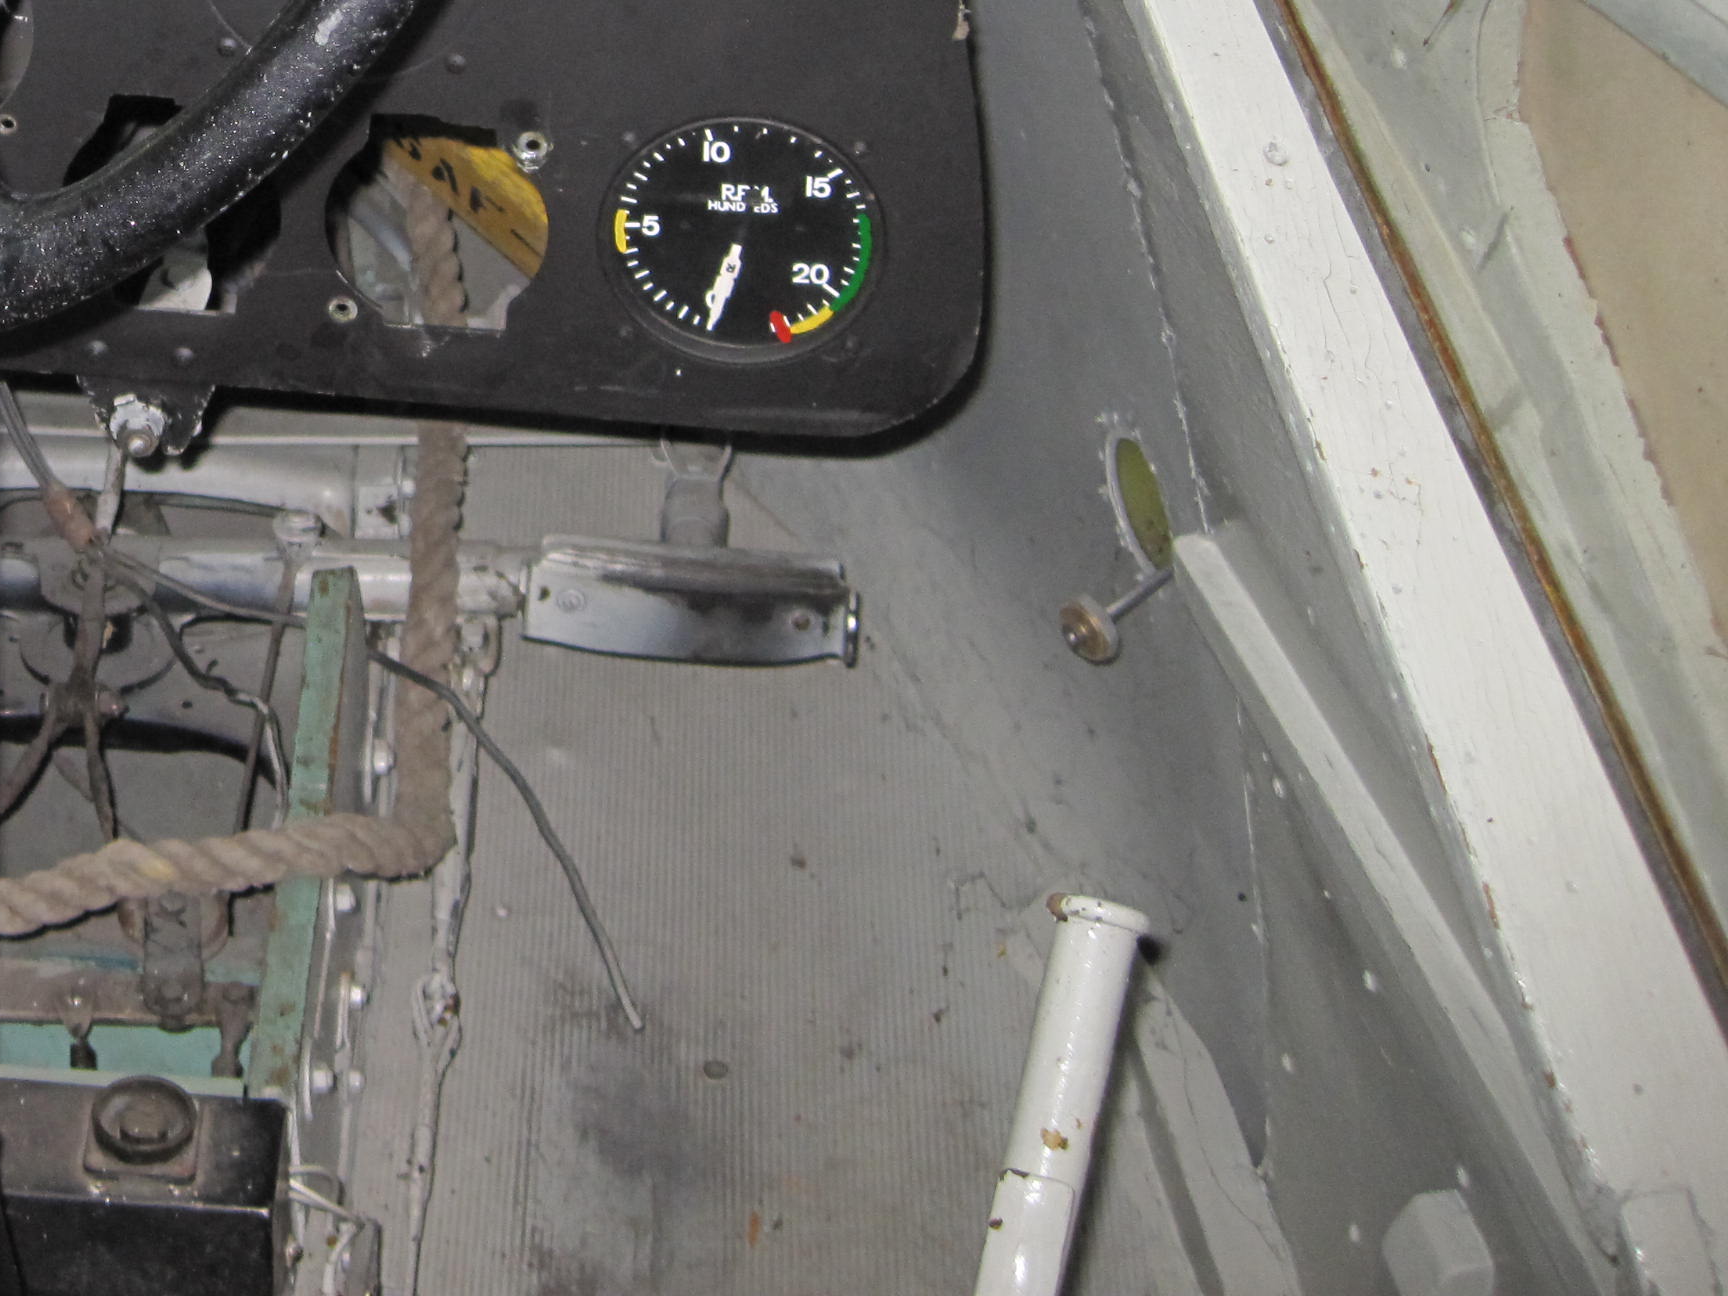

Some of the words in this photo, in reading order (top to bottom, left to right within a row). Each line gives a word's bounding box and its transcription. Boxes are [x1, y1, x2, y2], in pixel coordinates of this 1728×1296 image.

[702, 141, 731, 163] 10
[721, 183, 774, 203] R.P.
[805, 176, 832, 198] 15
[707, 199, 780, 214] HUNDEDS
[641, 215, 661, 236] 5
[792, 262, 830, 285] 20
